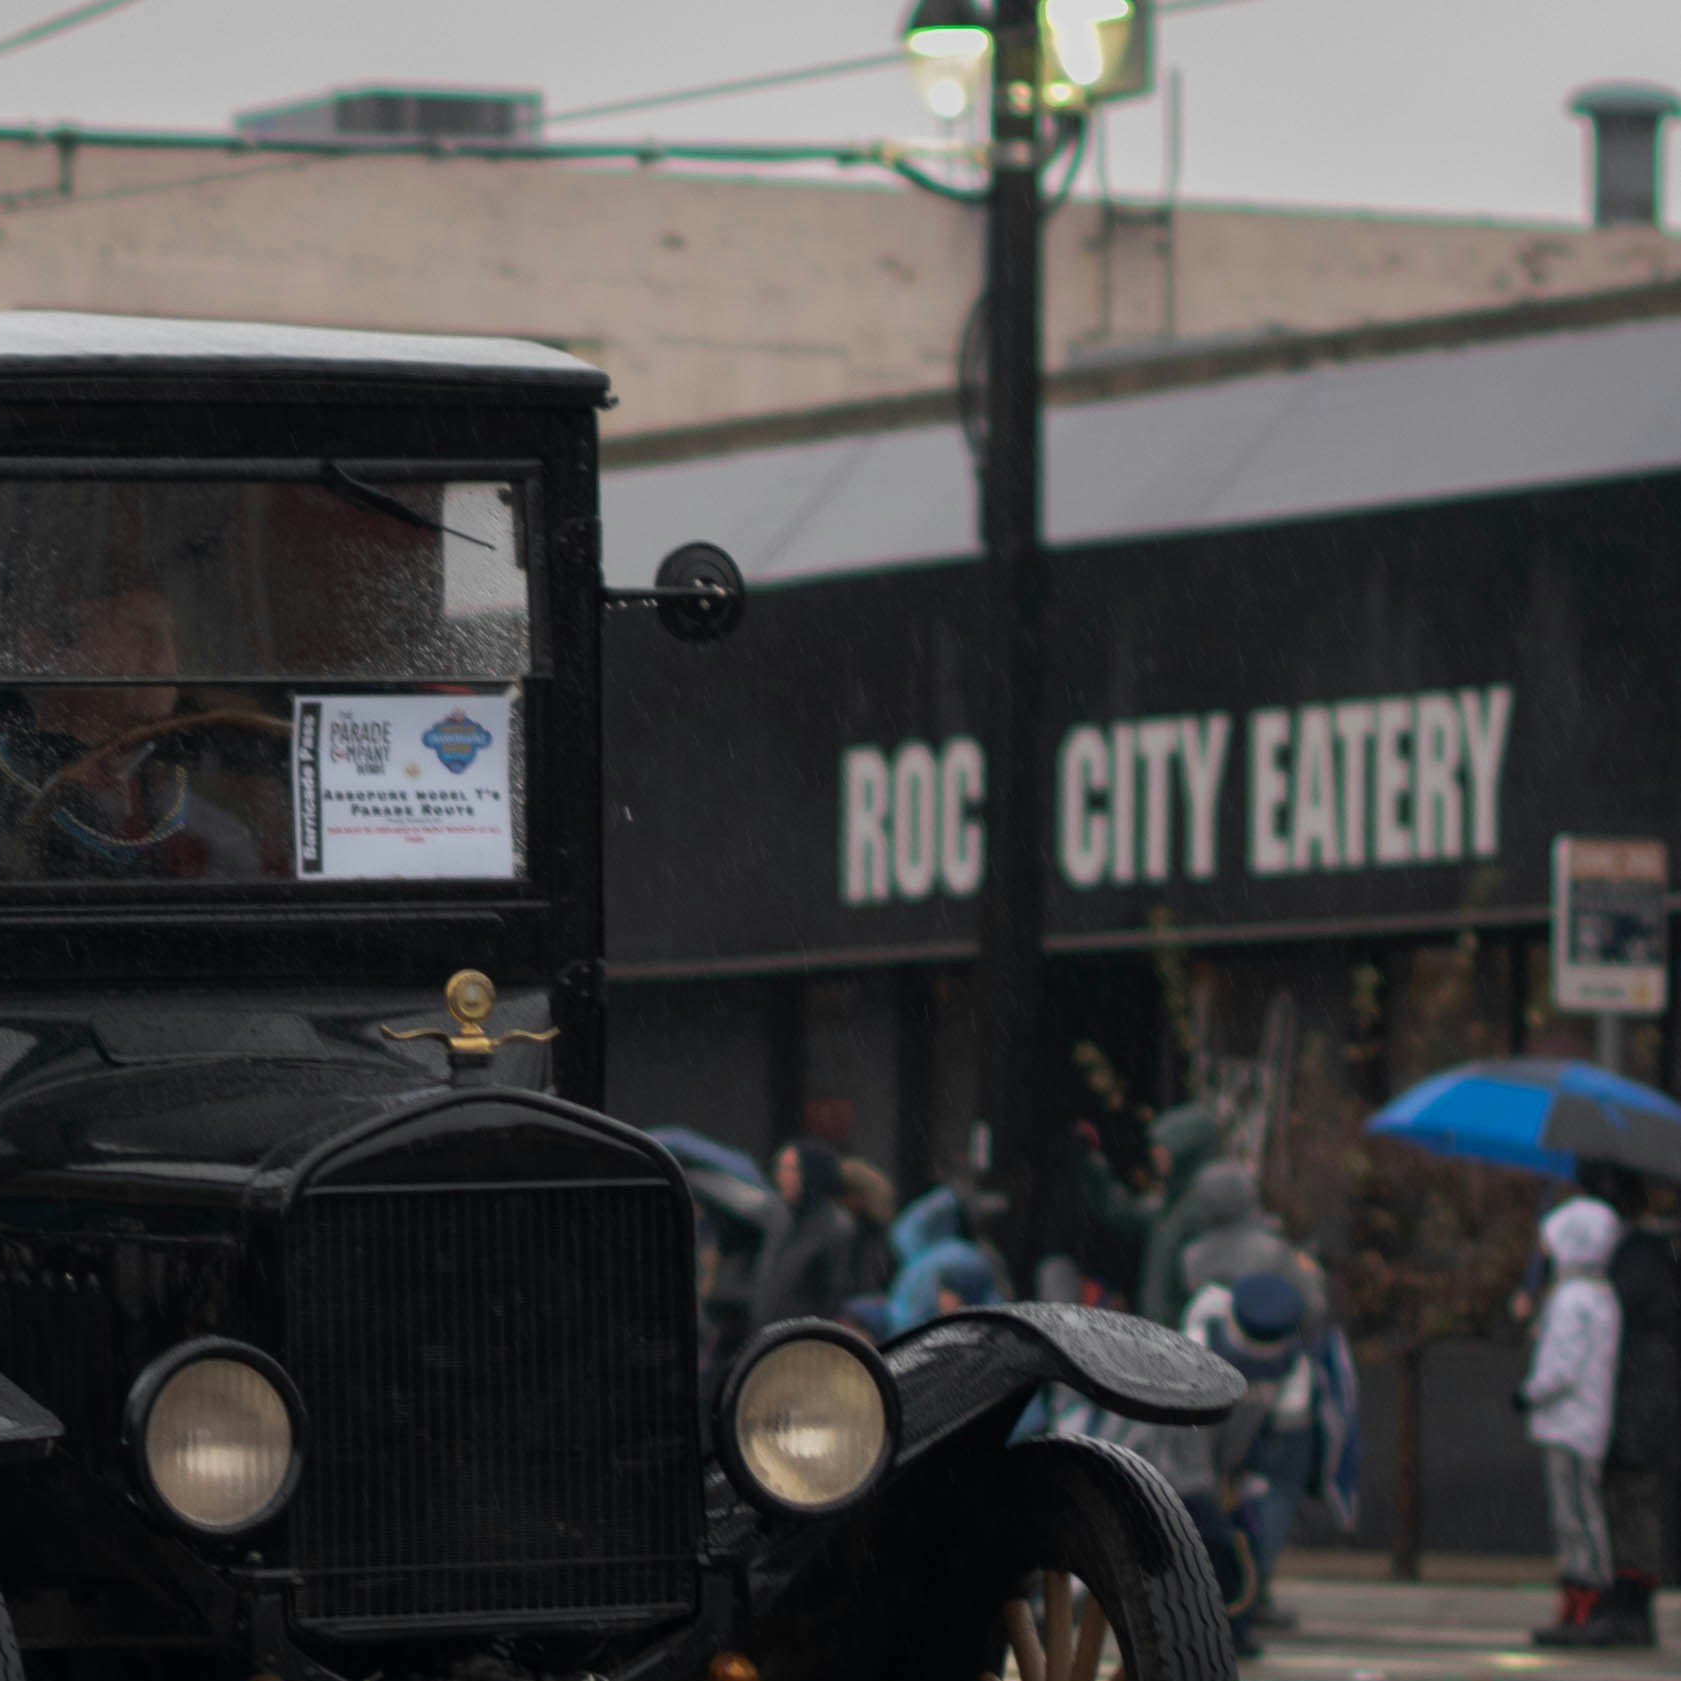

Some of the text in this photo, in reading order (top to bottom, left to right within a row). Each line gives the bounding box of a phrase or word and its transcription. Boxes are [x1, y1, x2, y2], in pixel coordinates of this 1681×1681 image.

[330, 720, 392, 745] PARADE
[1060, 714, 1229, 885] CITY
[1251, 688, 1512, 875] EATERY
